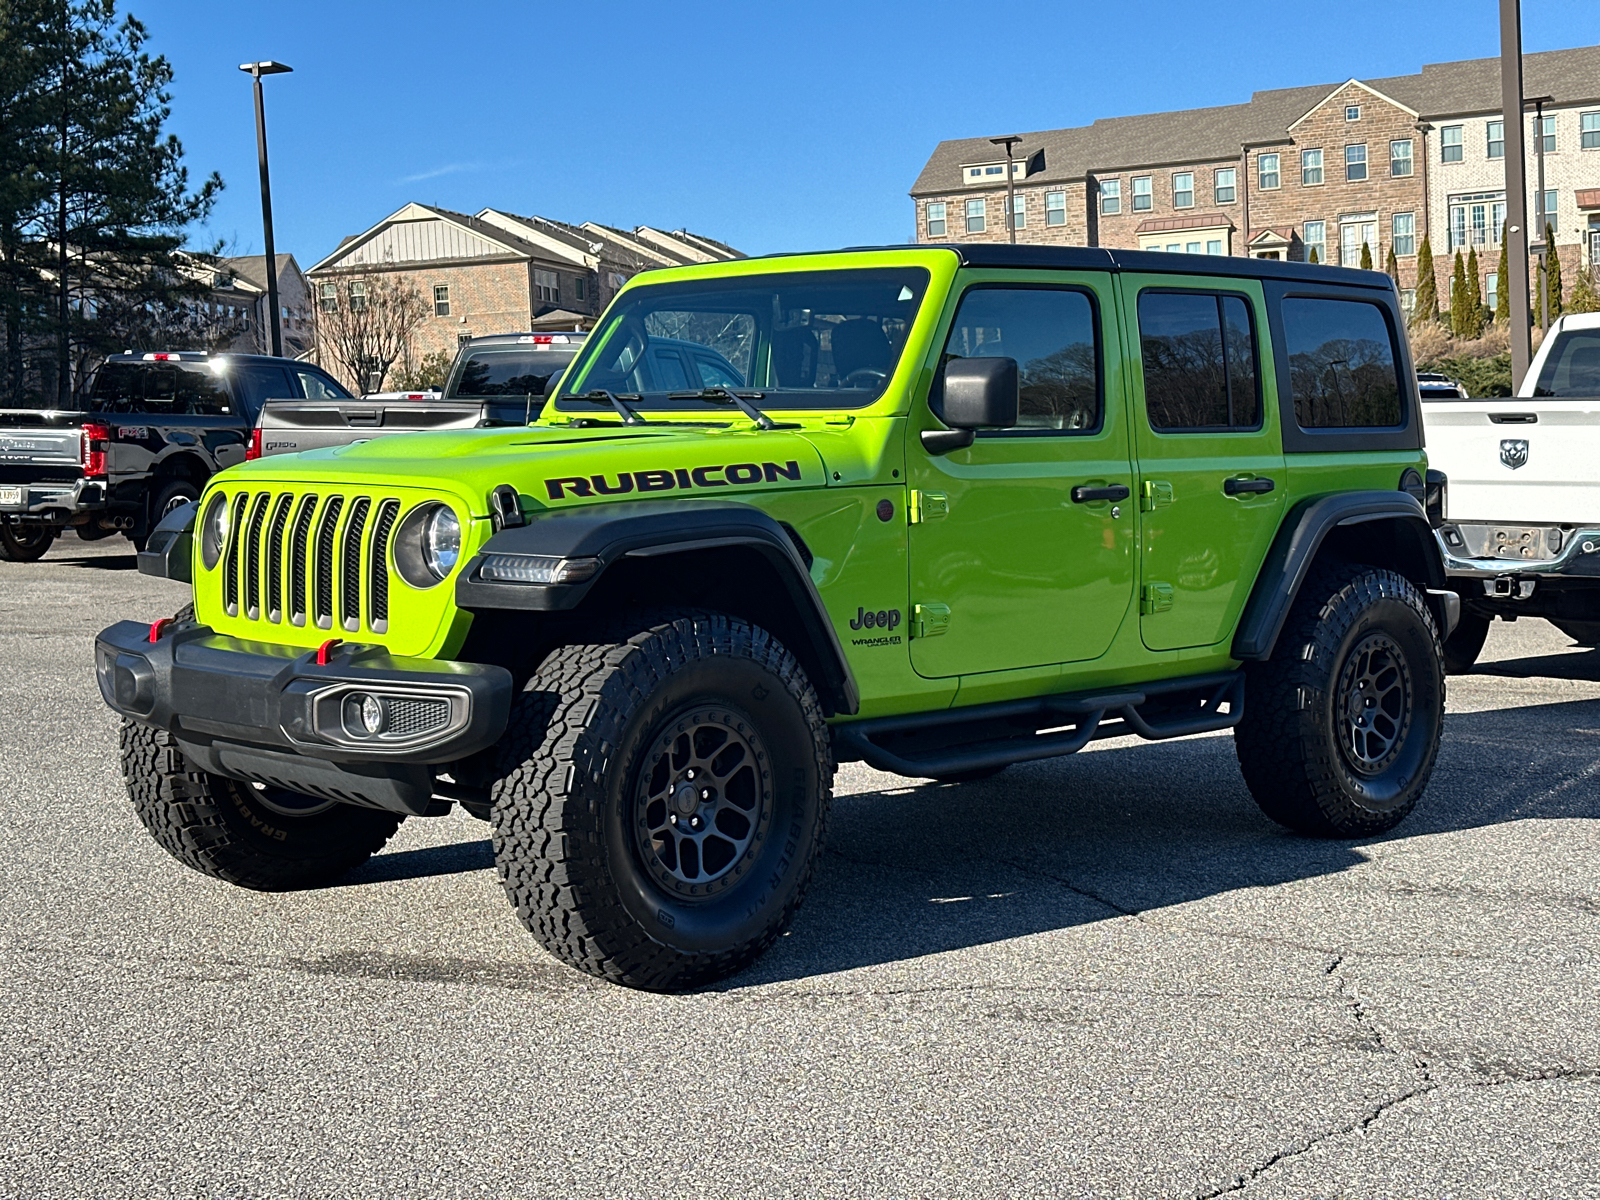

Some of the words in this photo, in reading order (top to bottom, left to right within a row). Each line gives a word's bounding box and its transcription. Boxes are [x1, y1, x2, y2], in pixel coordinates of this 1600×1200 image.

[544, 461, 802, 500] RUBICON
[849, 606, 901, 631] Jeep
[851, 636, 901, 646] WRANGLER
[225, 779, 288, 841] GRABBE
